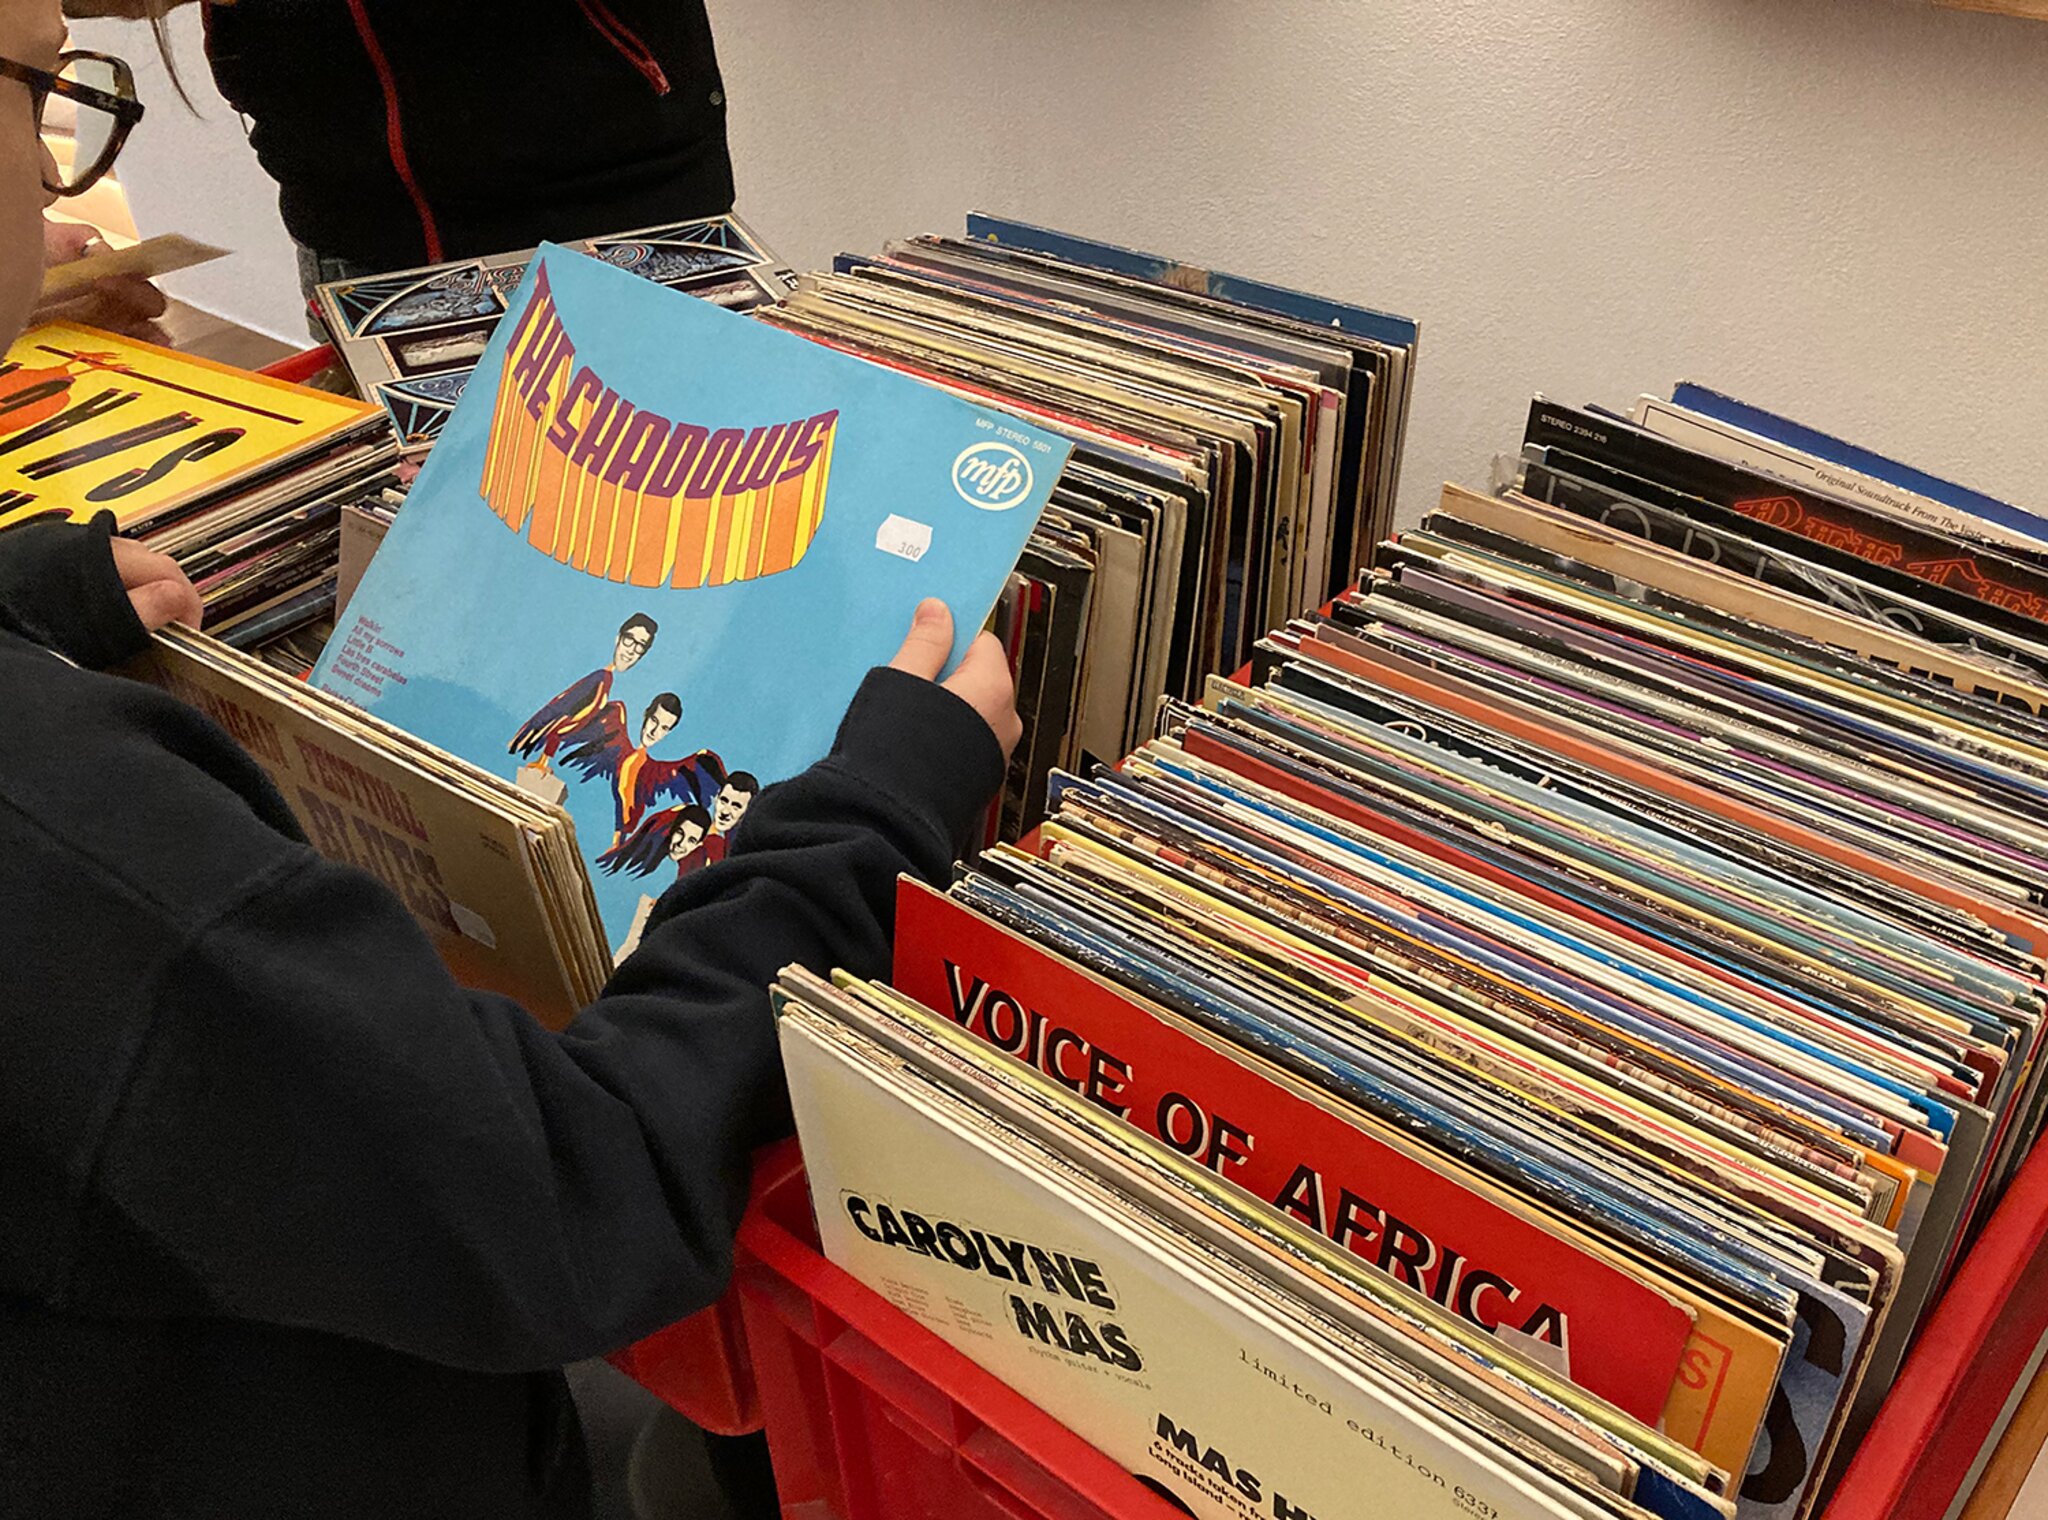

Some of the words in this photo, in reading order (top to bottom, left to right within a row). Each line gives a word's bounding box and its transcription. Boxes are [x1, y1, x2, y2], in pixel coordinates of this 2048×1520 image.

[546, 366, 839, 499] SHADOWS
[975, 417, 995, 430] MFP
[995, 426, 1031, 446] STEREO
[1540, 413, 1573, 432] STEREO
[959, 456, 1023, 500] mfp
[1815, 469, 1855, 494] Original
[1857, 484, 1912, 513] Soundtrack
[1912, 505, 1939, 524] From
[1940, 514, 1958, 532] The
[897, 541, 921, 559] 300
[943, 960, 1134, 1120] VOICE
[1157, 1091, 1256, 1188] OF
[1274, 1165, 1571, 1381] AFRICA
[846, 1195, 1117, 1312] CAROLYNE
[1009, 1294, 1143, 1373] MAS
[1238, 1348, 1334, 1417] limited
[1346, 1417, 1447, 1489] edition
[1148, 1446, 1181, 1478] Long
[1183, 1470, 1224, 1505] Island
[1156, 1412, 1263, 1504] MAS
[1165, 1448, 1205, 1482] tracks
[1207, 1477, 1247, 1511] taken
